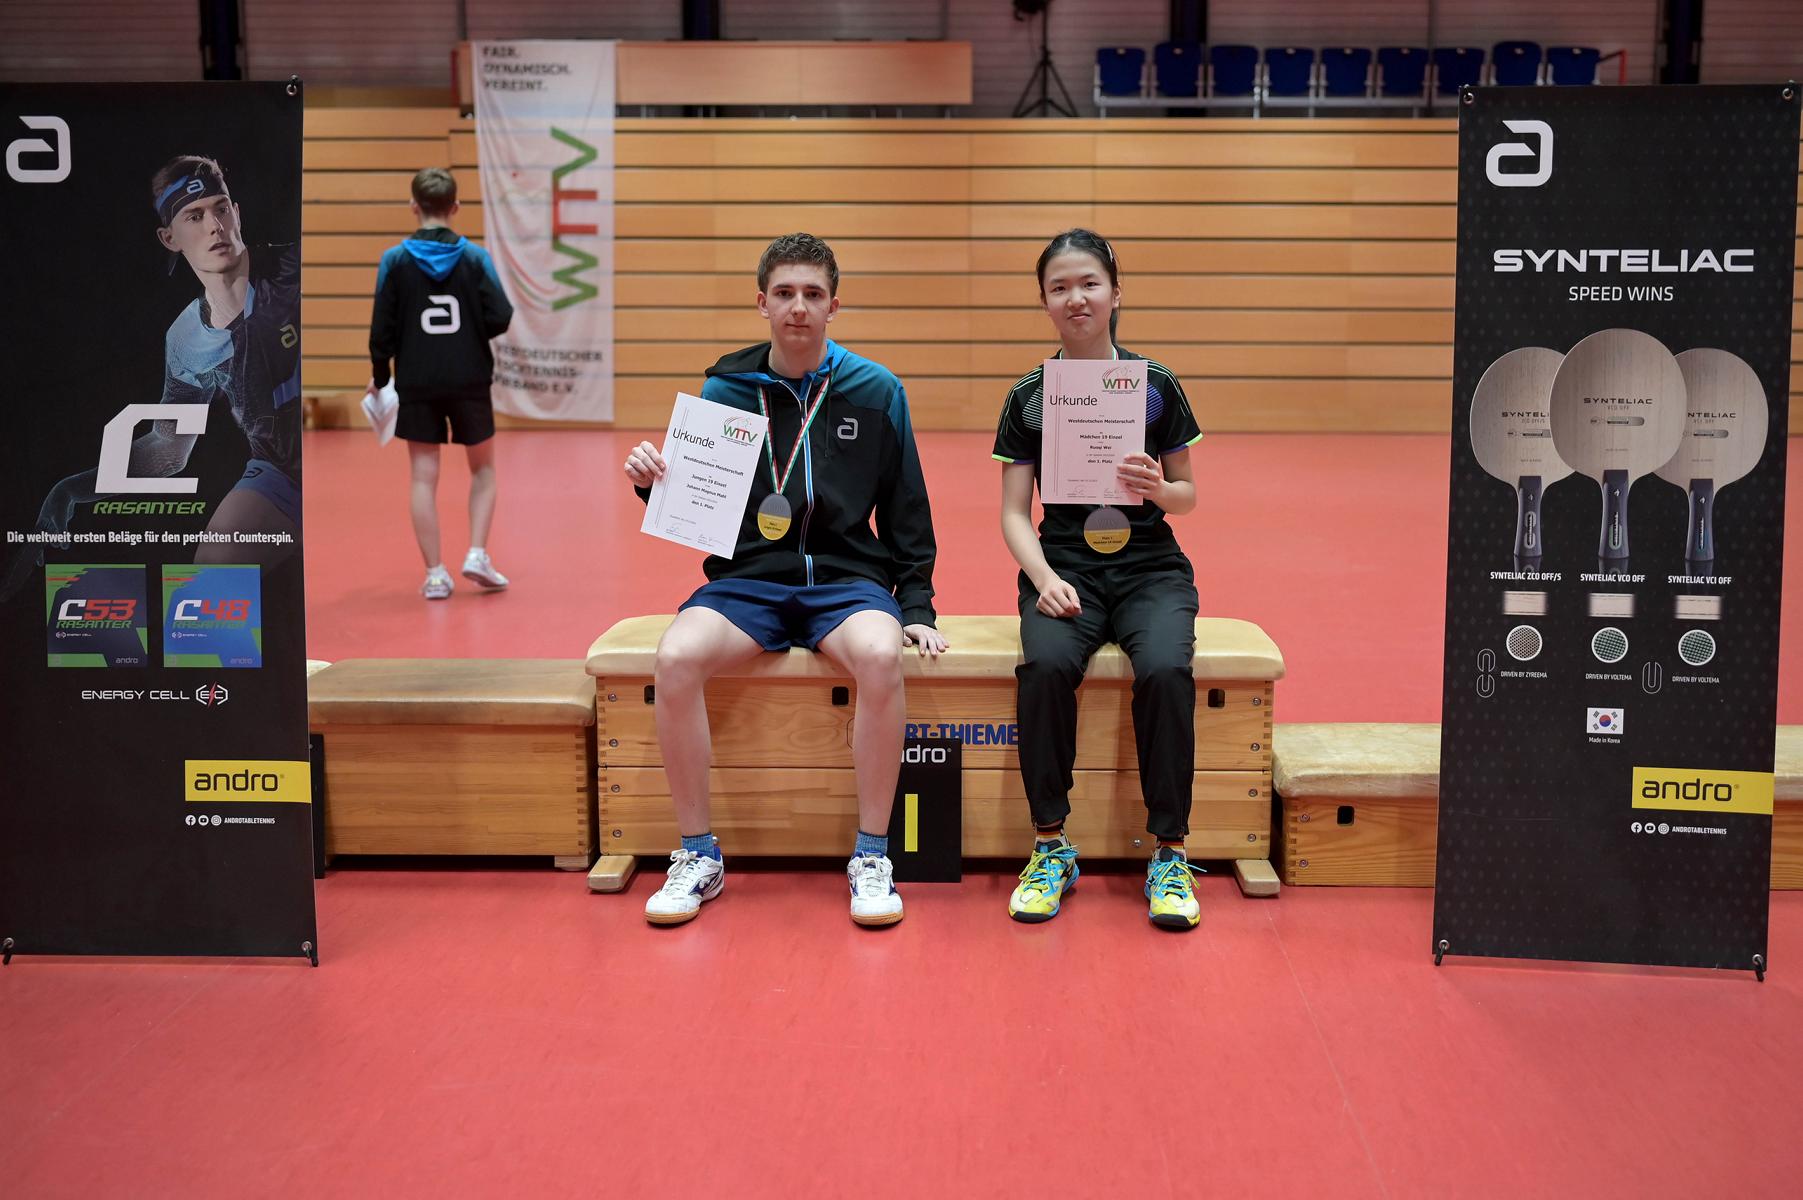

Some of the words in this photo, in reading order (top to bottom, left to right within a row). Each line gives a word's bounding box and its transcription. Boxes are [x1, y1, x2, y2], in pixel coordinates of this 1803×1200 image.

[550, 126, 599, 312] WTTV
[1493, 248, 1755, 273] SYNTELIAC
[1568, 285, 1623, 302] SPEED
[1627, 286, 1674, 302] WINS
[1102, 378, 1140, 389] WTTV
[1049, 395, 1098, 406] Urkunde
[1583, 397, 1653, 405] SYNTELIAC
[672, 427, 715, 449] Urkunde
[723, 424, 758, 443] WTTV
[93, 501, 206, 514] RASANTER
[7, 531, 24, 543] Die
[27, 531, 71, 543] weltweit
[74, 533, 106, 543] ersten
[108, 531, 141, 546] Beläge
[144, 531, 159, 543] für
[162, 531, 180, 543] den
[183, 531, 231, 546] perfekten
[233, 531, 294, 546] Counterspin.
[1490, 571, 1526, 580] SYNTELIAC
[1527, 572, 1540, 580] ZCO
[1541, 572, 1562, 581] OFF/S
[1580, 573, 1617, 582] SYNTELIAC
[1617, 574, 1631, 582] VCO
[1632, 574, 1645, 583] OFF
[1667, 575, 1705, 584] SYNTELIAC
[1705, 576, 1717, 584] VCI
[1718, 576, 1732, 585] OFF
[58, 599, 137, 621] C53
[174, 598, 252, 621] C48
[56, 620, 132, 629] RASANTER
[115, 656, 138, 664] andro
[1525, 671, 1548, 679] ZYREEMA
[1672, 675, 1690, 683] DRIVEN
[81, 690, 145, 700] ENERGY
[149, 690, 190, 700] CELL
[194, 769, 278, 792] andro
[1641, 778, 1732, 802] andro
[224, 817, 276, 825] ANDROTABLETENNIS
[1671, 826, 1727, 835] ANDROTABLETENNIS
